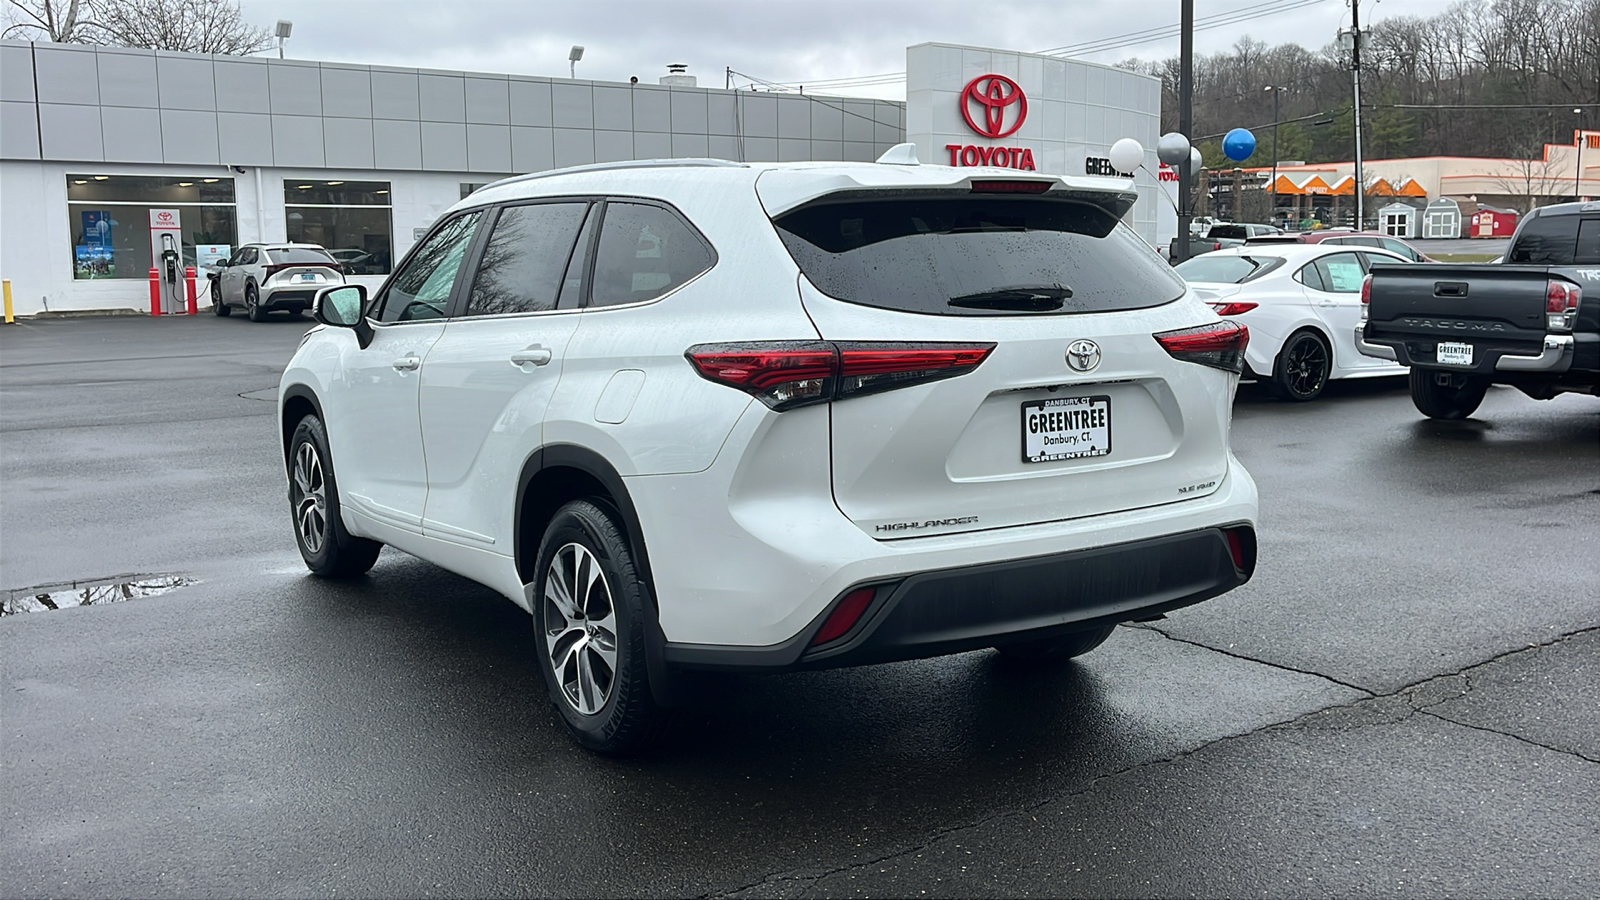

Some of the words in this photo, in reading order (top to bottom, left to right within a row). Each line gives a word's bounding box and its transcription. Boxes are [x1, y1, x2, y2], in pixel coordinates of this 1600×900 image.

[946, 145, 1036, 171] TOYOTA
[1086, 157, 1135, 178] GREEN
[1404, 319, 1505, 332] TACOMA
[1439, 345, 1472, 355] GREENTREE
[1029, 408, 1105, 434] GREENTREE
[1044, 433, 1080, 446] Danbury,
[1081, 431, 1092, 442] CT.
[1031, 449, 1108, 462] GREENTREE
[875, 515, 979, 532] HIGHLANDER
